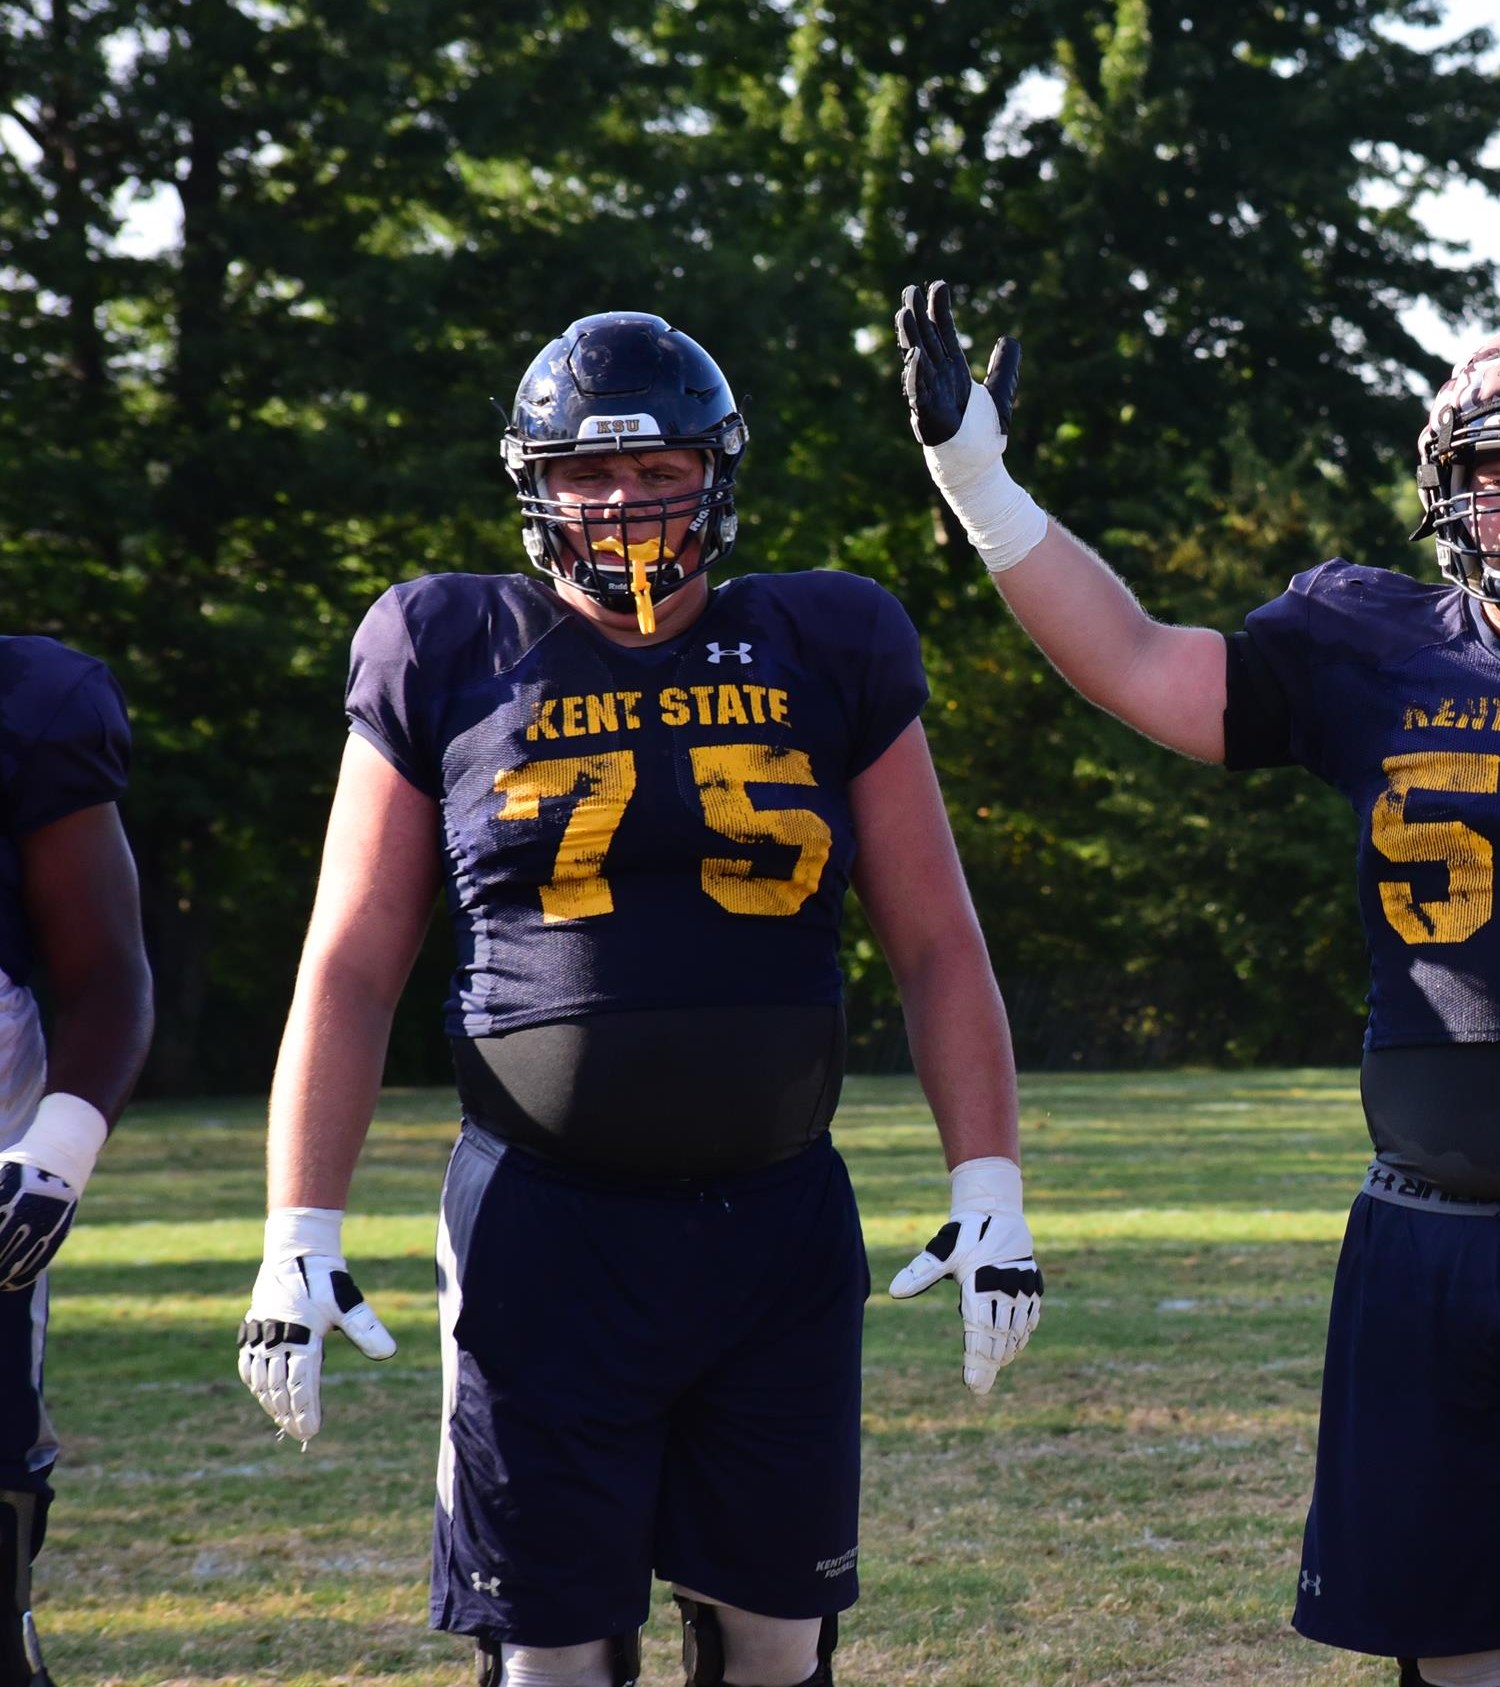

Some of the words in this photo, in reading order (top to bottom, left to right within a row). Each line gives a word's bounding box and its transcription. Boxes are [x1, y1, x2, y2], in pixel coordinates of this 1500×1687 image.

[597, 419, 639, 433] KSU
[526, 690, 642, 742] KENT
[659, 684, 792, 728] STATE
[493, 743, 832, 924] 75
